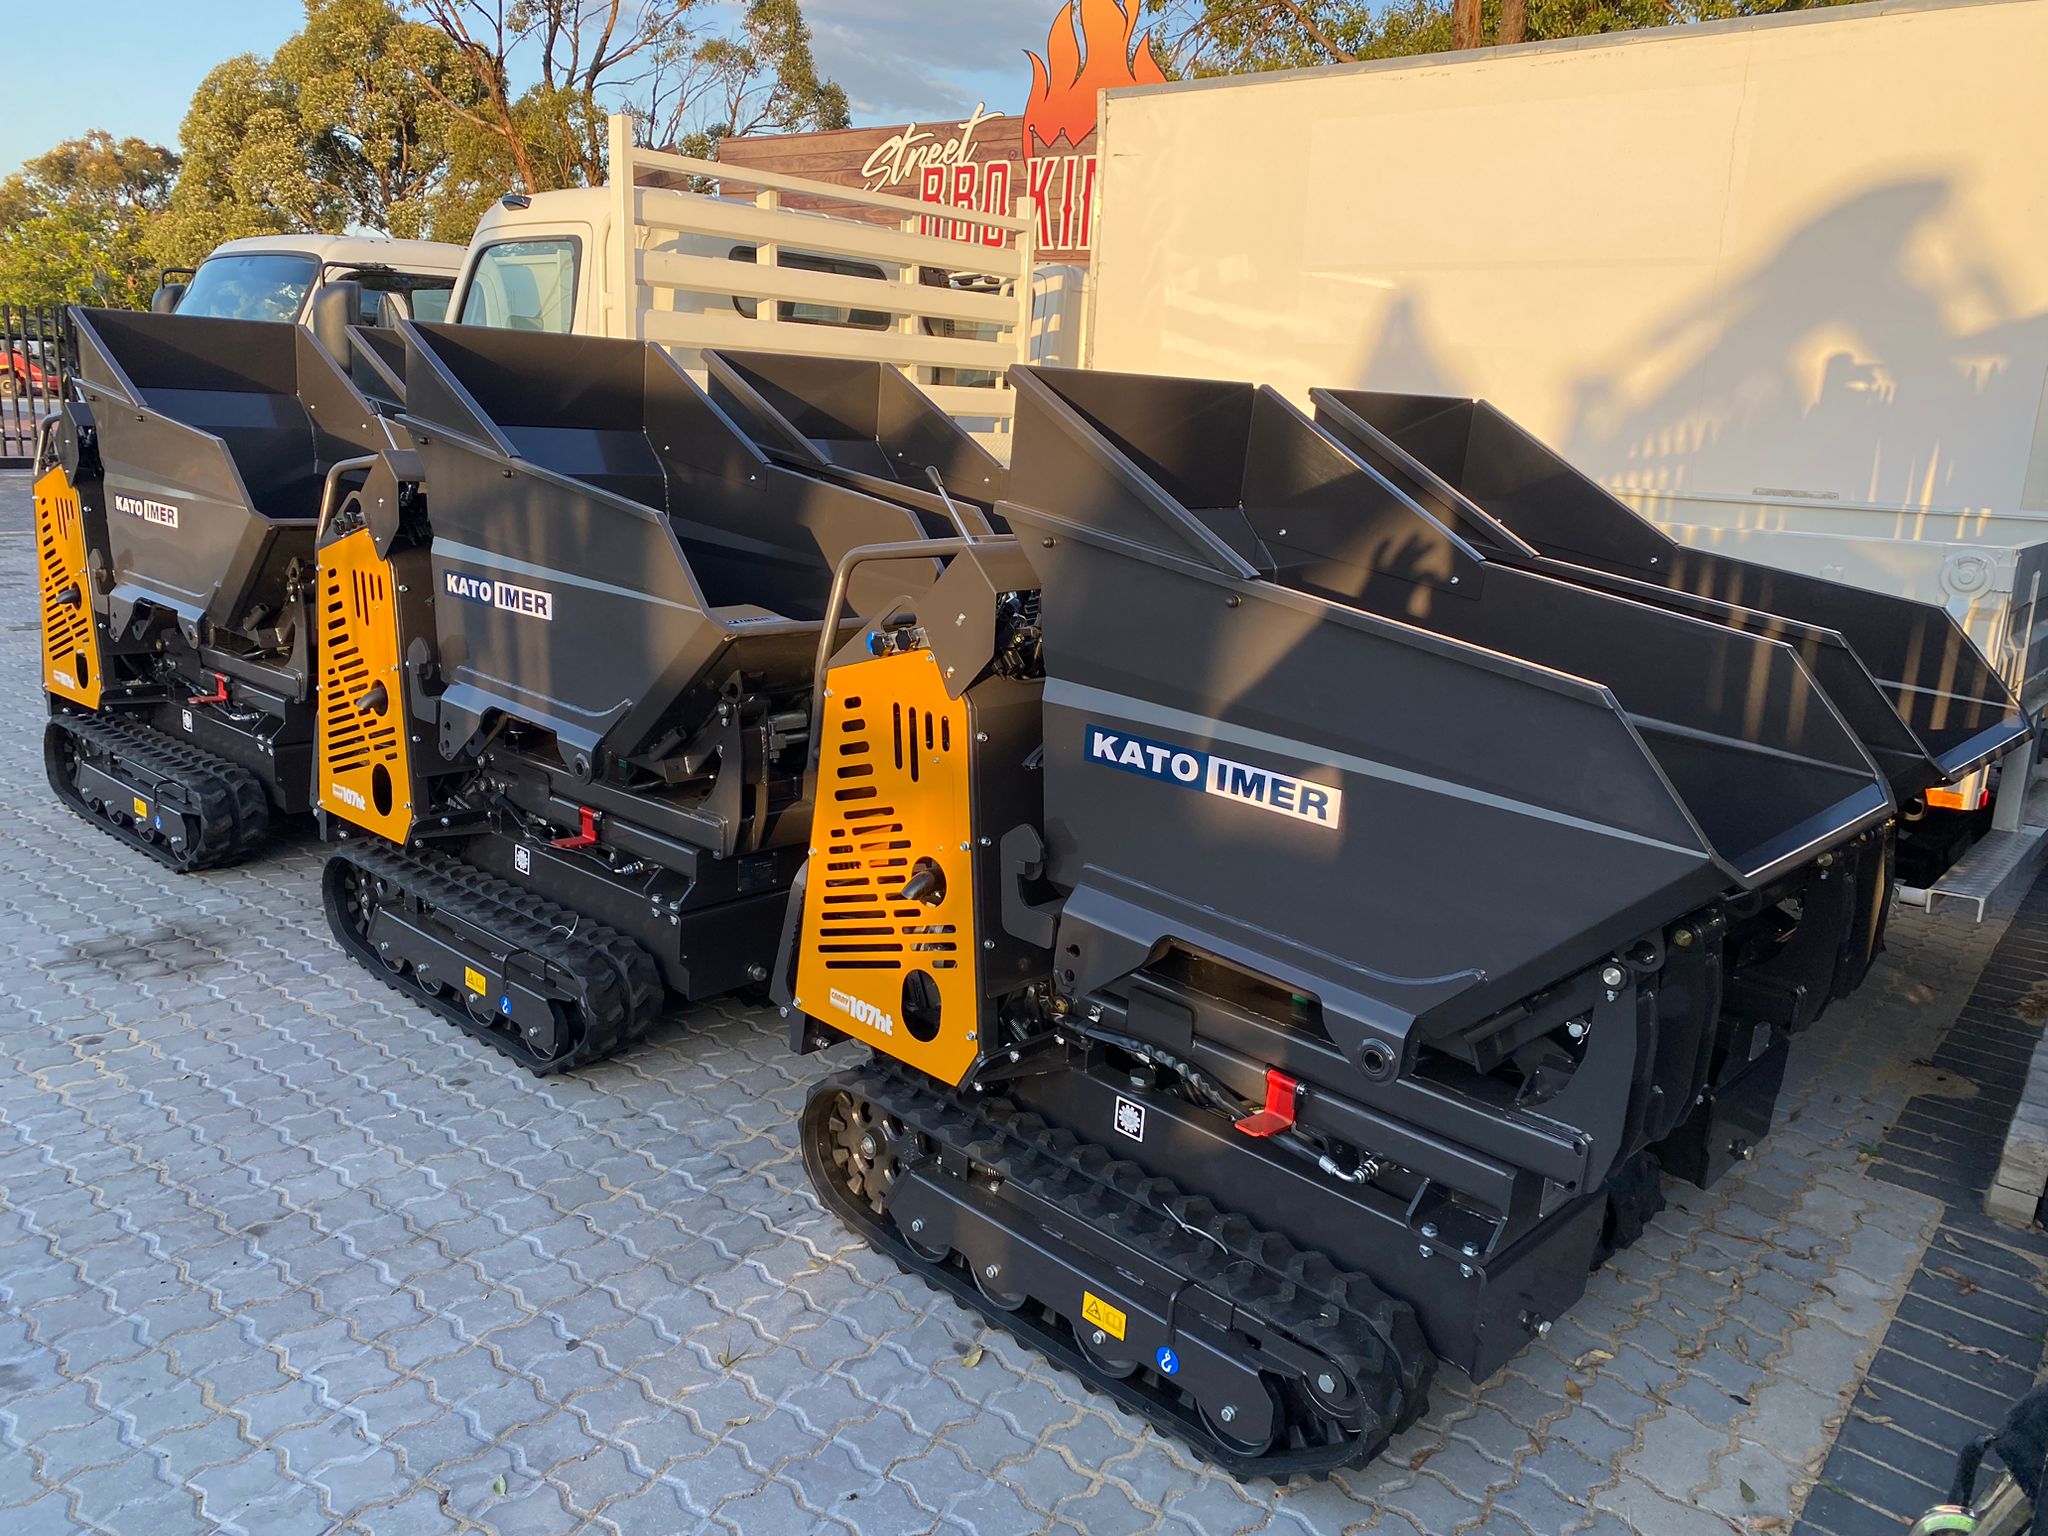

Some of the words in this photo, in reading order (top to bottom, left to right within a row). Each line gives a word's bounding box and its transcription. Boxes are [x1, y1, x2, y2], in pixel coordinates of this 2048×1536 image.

[862, 101, 1005, 193] Street
[115, 495, 144, 517] KATO
[146, 502, 175, 525] IMER
[446, 573, 492, 602] KATO
[498, 585, 547, 616] IMER
[1092, 731, 1199, 783] KATO
[1216, 762, 1329, 821] IMER
[849, 995, 893, 1036] 107ht
